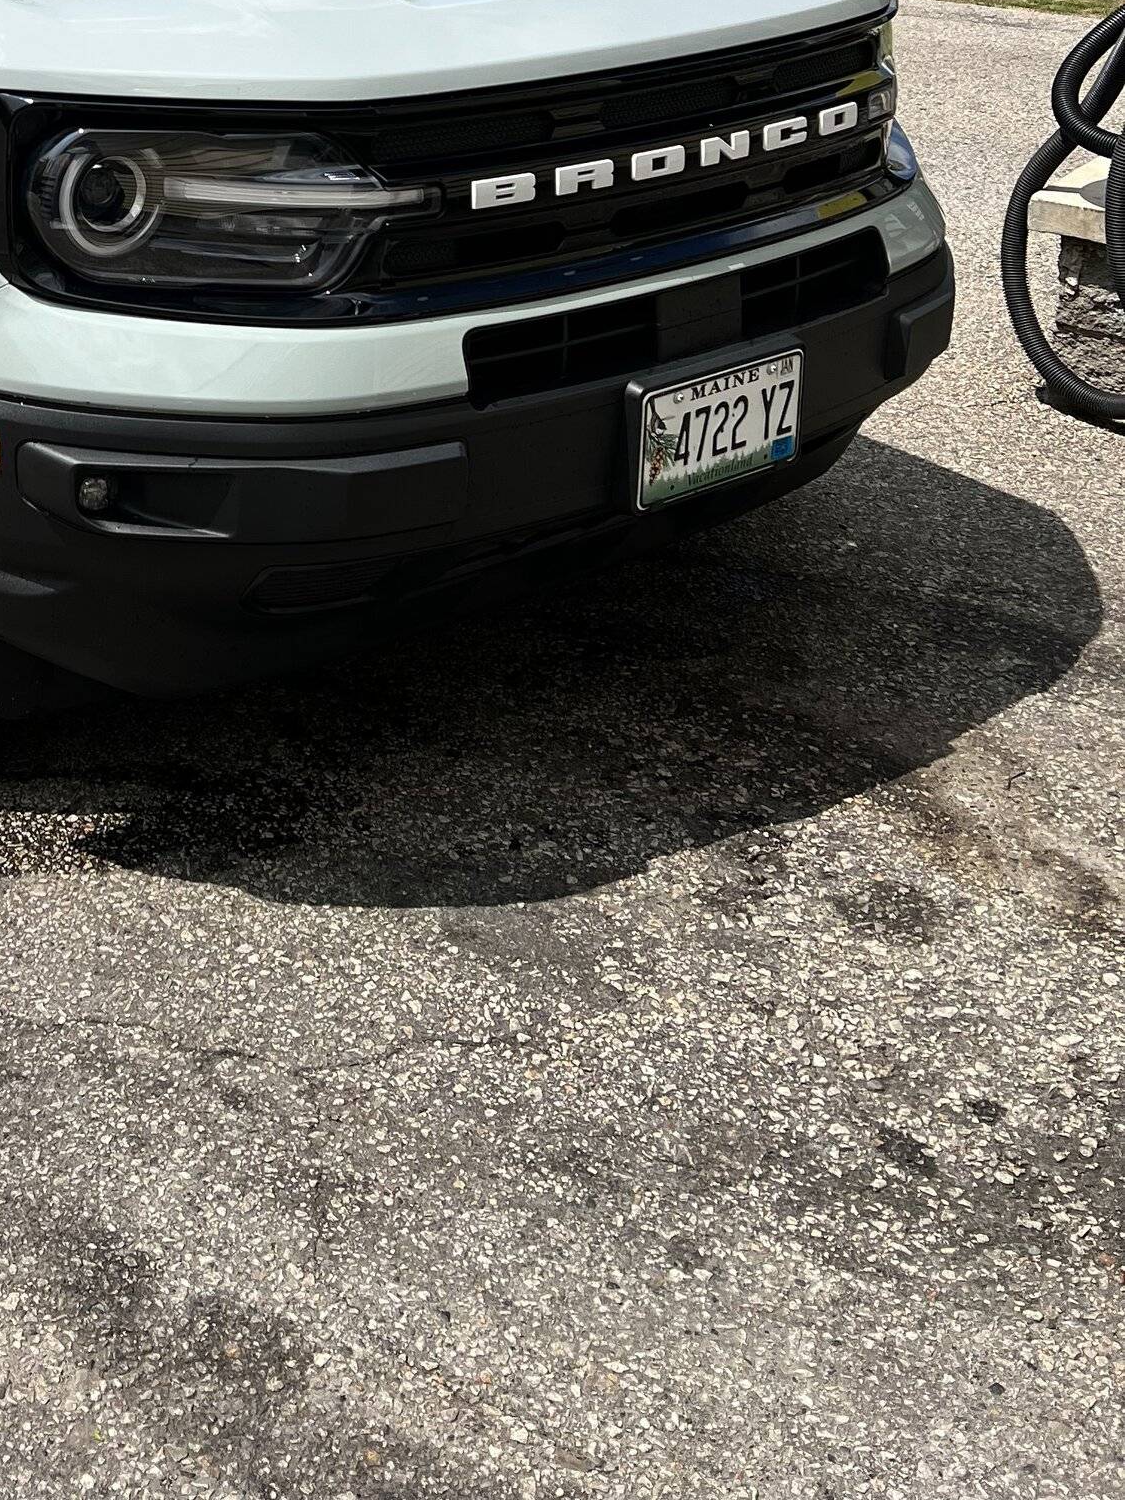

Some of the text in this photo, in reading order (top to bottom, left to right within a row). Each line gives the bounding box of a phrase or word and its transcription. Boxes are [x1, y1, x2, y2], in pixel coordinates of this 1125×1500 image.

[471, 101, 859, 210] BRONCO
[689, 367, 761, 401] MAINE
[674, 379, 795, 466] 4722 YZ
[686, 453, 754, 486] Vacationland
